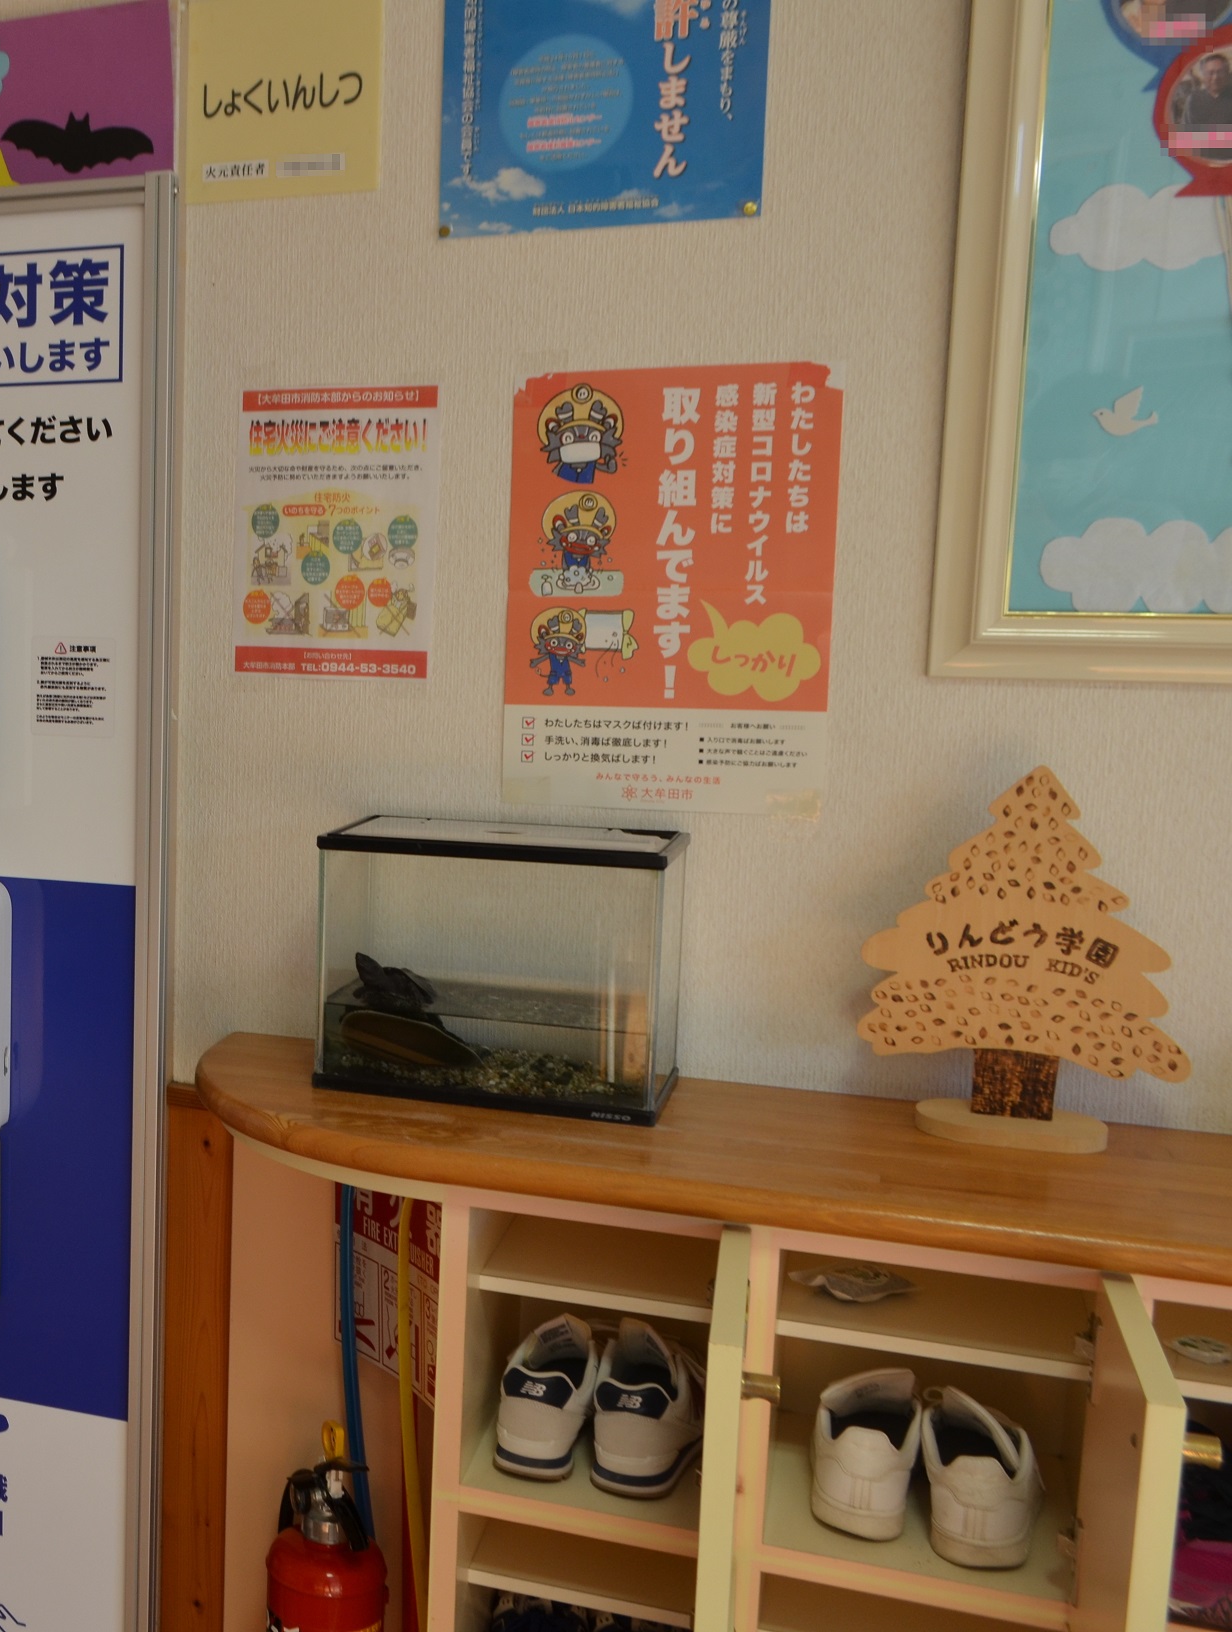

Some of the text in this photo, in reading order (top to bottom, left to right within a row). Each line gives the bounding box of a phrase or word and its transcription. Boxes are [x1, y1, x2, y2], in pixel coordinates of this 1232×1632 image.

[203, 72, 363, 119] しょくいんしつ
[205, 163, 265, 179] 火元責任者
[249, 418, 428, 456] 住宅火災にご注意ください！
[785, 381, 815, 533] わたしたちは
[710, 383, 740, 534] 感染症対策に
[314, 492, 351, 503] 住宅防火
[744, 382, 778, 606] 新型コロナウイルス
[653, 386, 701, 700] 取り組んでます！
[301, 662, 416, 675] TEL:0944-53-3540
[710, 644, 797, 679] しっかり
[641, 788, 693, 800] 大牟田市
[926, 918, 1120, 969] りんどう学園
[945, 953, 1100, 985] RINDOU KID'S
[362, 1216, 381, 1242] FIRE
[383, 1225, 434, 1278] EXTUISHER
